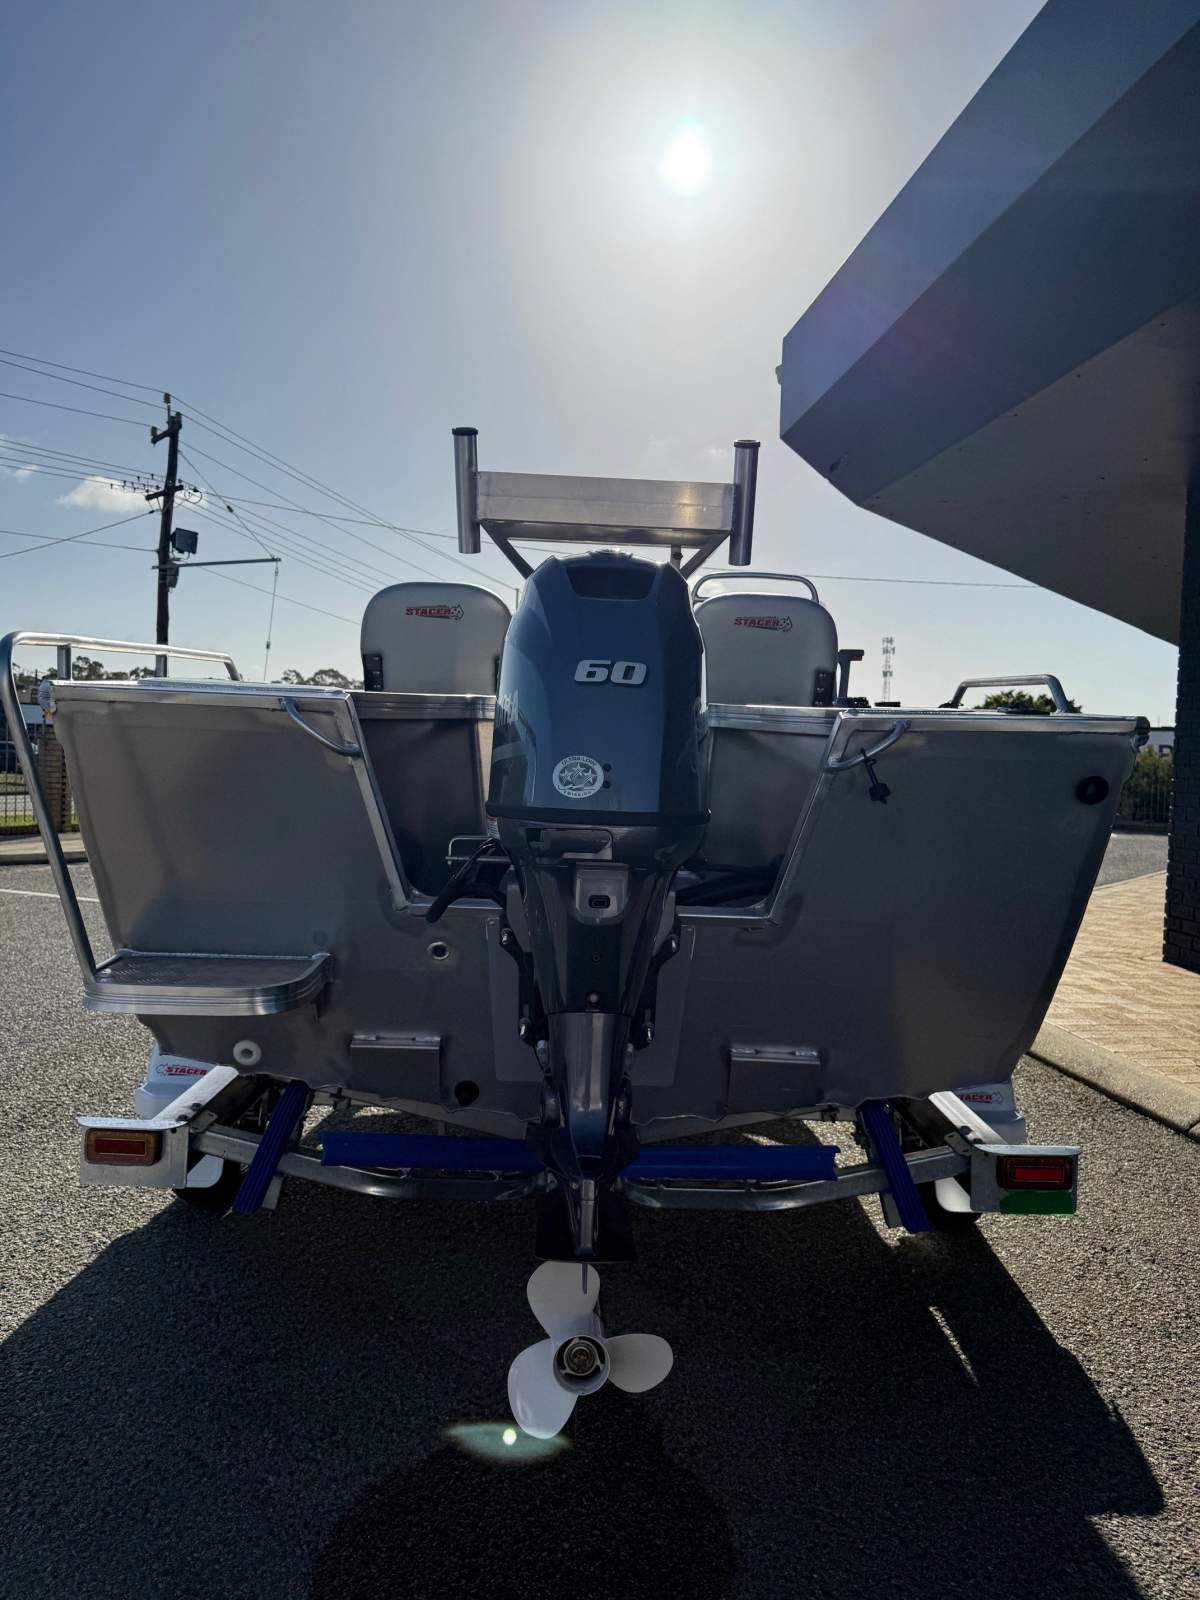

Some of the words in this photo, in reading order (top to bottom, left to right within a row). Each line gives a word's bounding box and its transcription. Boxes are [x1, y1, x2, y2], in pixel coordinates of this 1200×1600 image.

[405, 606, 450, 617] STACER
[734, 618, 780, 627] STACER
[574, 659, 647, 685] 60
[165, 1066, 208, 1076] STACER
[959, 1094, 992, 1102] TACER
